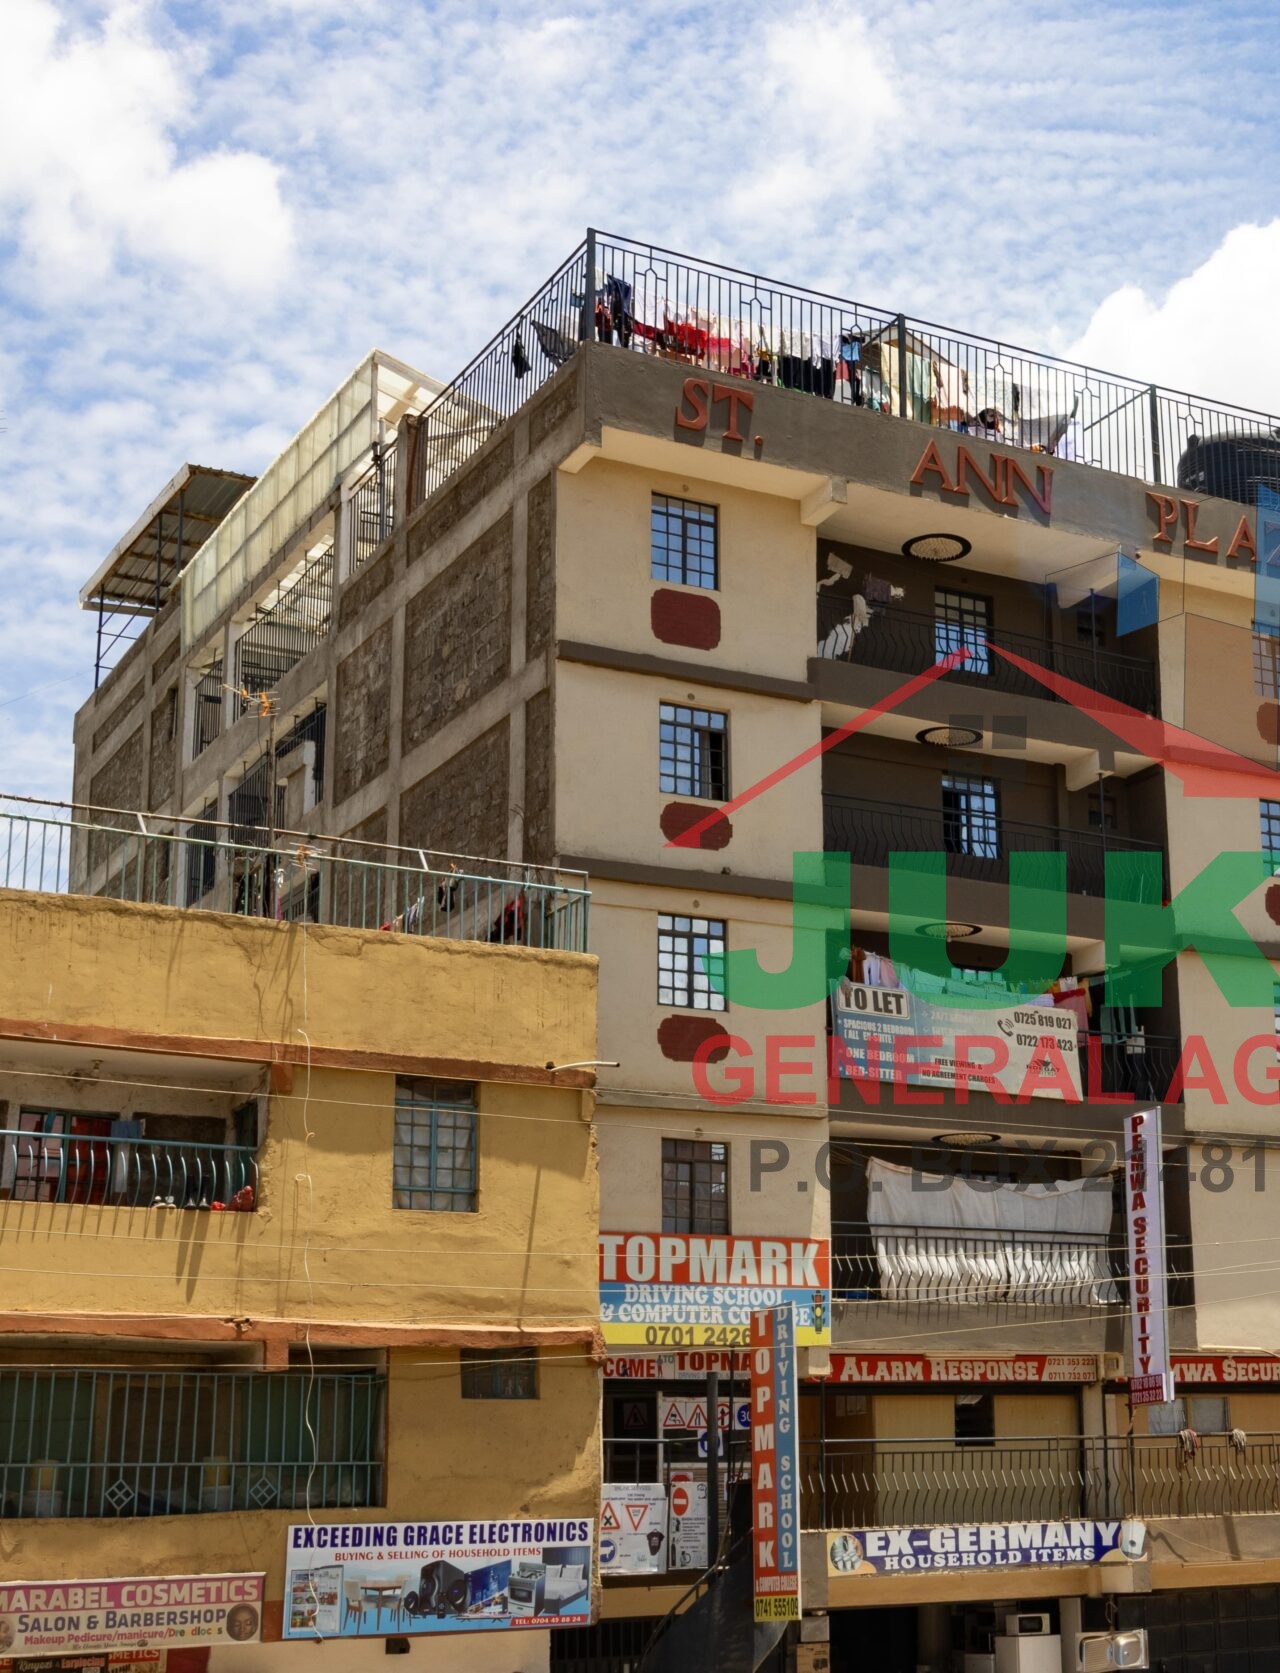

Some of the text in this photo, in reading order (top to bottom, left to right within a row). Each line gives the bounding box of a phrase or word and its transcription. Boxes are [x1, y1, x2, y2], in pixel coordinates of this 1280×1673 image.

[675, 377, 763, 445] ST.
[911, 438, 1053, 514] ANN
[841, 988, 904, 1016] TO LET
[843, 1018, 876, 1032] SPACIOUS
[883, 1023, 915, 1036] BEDROOM
[1014, 1012, 1072, 1030] 0725 819 027
[1016, 1034, 1074, 1052] 0722 173 423
[846, 1047, 915, 1064] ONE BEDROOM
[934, 1058, 948, 1067] FREE
[948, 1058, 976, 1070] VIEWING
[845, 1064, 902, 1081] BED-SITTER
[922, 1069, 996, 1084] NO AGREEMENT CHARGES
[599, 1234, 820, 1287] TOPMARK
[625, 1283, 785, 1306] DRIVING SCHOOL
[1133, 1216, 1152, 1375] SECURITY
[600, 1303, 614, 1322] &
[618, 1303, 725, 1325] COMPUTER
[645, 1325, 695, 1346] 0701
[603, 1357, 656, 1378] COME
[839, 1356, 1039, 1382] ALARM RESPONSE
[1047, 1358, 1065, 1366] 0721
[1048, 1372, 1095, 1381] 0711 732 071
[754, 1309, 776, 1568] TOPMARK
[776, 1304, 793, 1568] DRIVING SCHOOL
[292, 1521, 589, 1549] EXCEEDING GRACE ELECTRONICS
[865, 1520, 1122, 1558] EX-GERMANY
[335, 1547, 541, 1562] BUYING & SELLING OF HOUSEHOLD ITEMS
[884, 1547, 1096, 1570] HOUSEHOLD ITEMS
[121, 1579, 259, 1607] COSMETICS
[760, 1576, 780, 1593] COMPUTER
[781, 1575, 798, 1591] COLLEGE
[755, 1597, 799, 1618] 0741 555109
[17, 1608, 227, 1634] SALON & BARBERSHOP
[24, 1633, 65, 1646] Makeup
